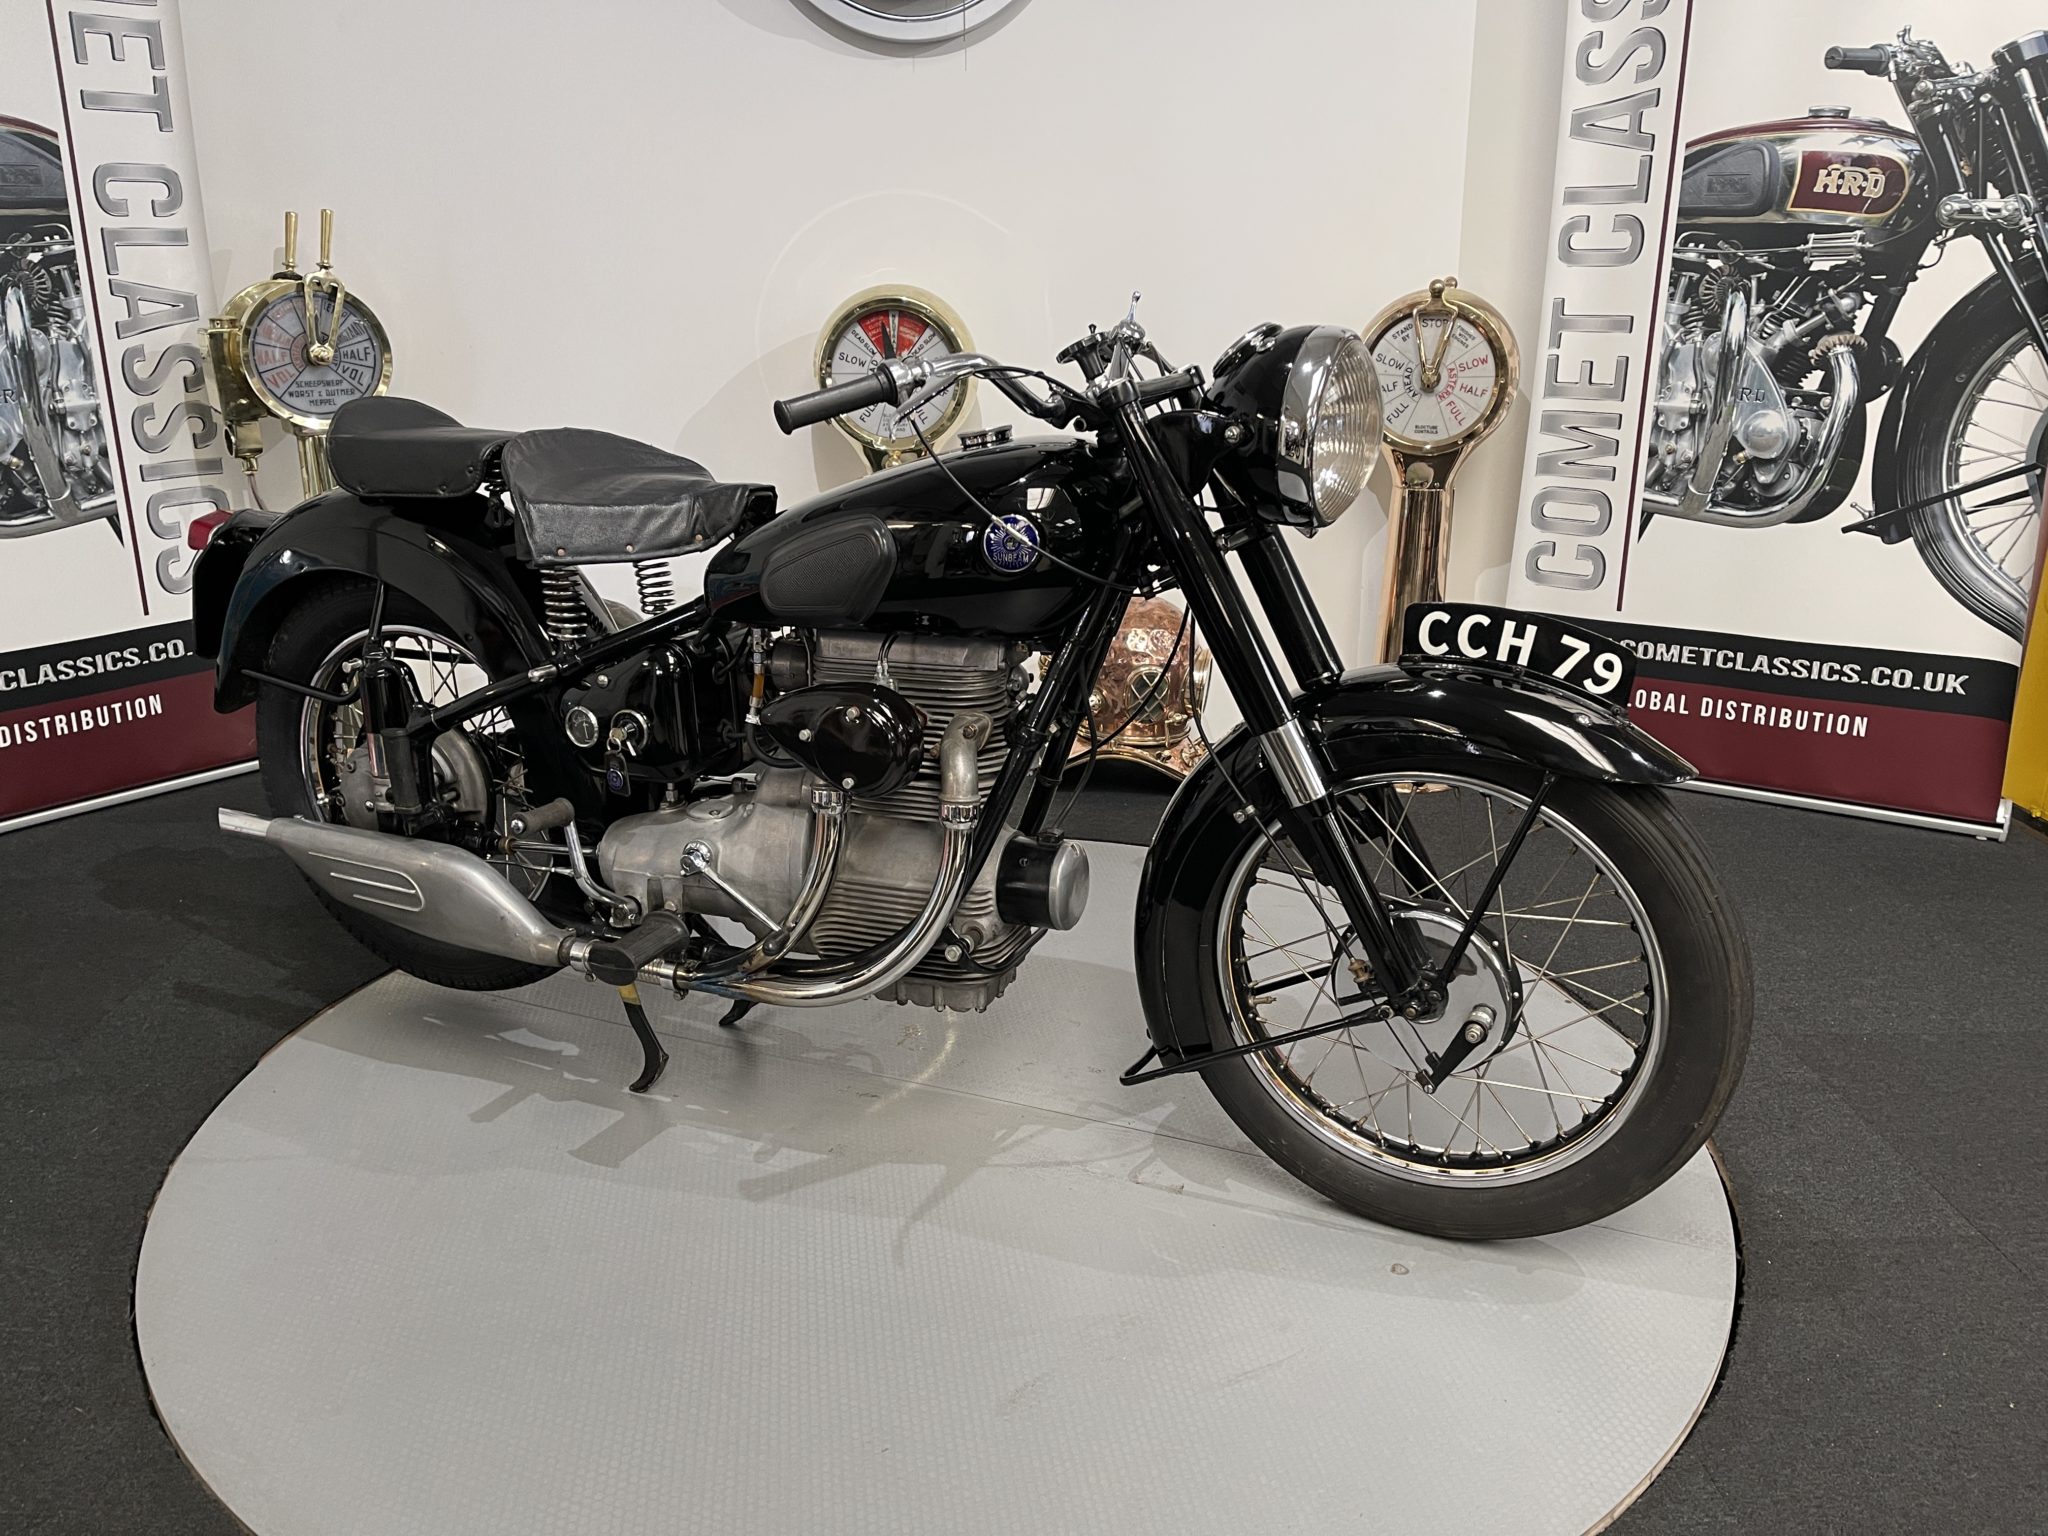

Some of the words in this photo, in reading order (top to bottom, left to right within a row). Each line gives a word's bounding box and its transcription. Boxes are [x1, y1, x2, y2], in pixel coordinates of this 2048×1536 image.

[68, 0, 173, 132] ET
[1392, 323, 1414, 341] STAND
[1422, 318, 1450, 329] STOP
[851, 329, 865, 344] DEAD
[864, 342, 877, 355] SLOW
[1401, 333, 1411, 344] BY
[343, 347, 371, 362] HALF
[911, 343, 925, 356] DEAD
[838, 352, 867, 368] SLOW
[1375, 353, 1405, 371] SLOW
[1458, 354, 1489, 373] SLOW
[267, 369, 295, 389] VOL
[341, 365, 364, 386] VOL
[1404, 366, 1419, 399] AHEAD
[1437, 367, 1458, 402] ASTERN
[288, 389, 314, 399] WORST
[1381, 381, 1398, 394] ALF
[1459, 382, 1489, 399] HALF
[309, 398, 337, 407] MEPPEL
[1386, 402, 1410, 425] FULL
[1445, 400, 1467, 426] FULL
[1524, 297, 1634, 591] COMET
[1418, 611, 1538, 667] CCH
[1552, 634, 1623, 695] 79
[0, 693, 163, 748] DISTRIBUTION
[1627, 689, 1690, 716] OBAL
[1701, 696, 1869, 738] DISTRIBUTION
